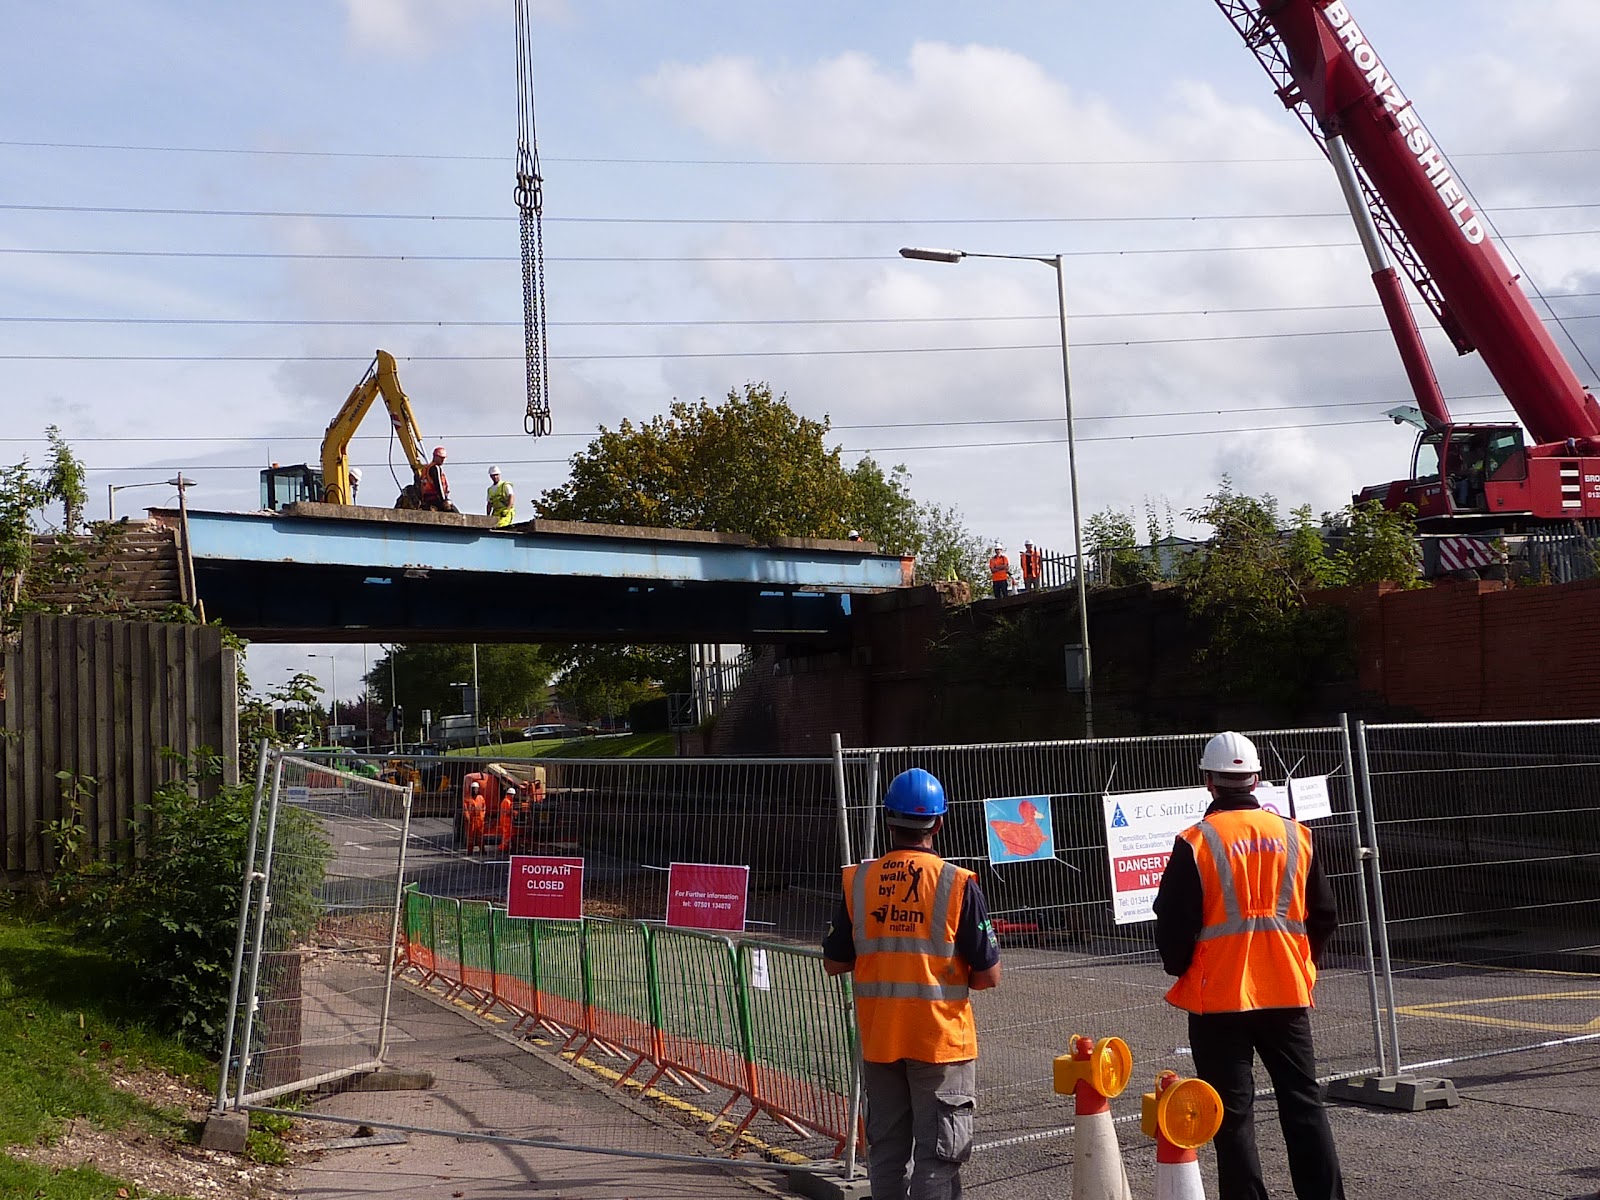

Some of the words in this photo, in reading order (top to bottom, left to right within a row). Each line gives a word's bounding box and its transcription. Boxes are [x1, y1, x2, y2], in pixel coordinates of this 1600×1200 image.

[1324, 0, 1485, 244] BRONZESHIELD
[1160, 802, 1194, 817] Saints
[521, 864, 571, 876] FOOTPATH
[882, 859, 915, 870] don't
[1118, 856, 1162, 873] DANGER
[880, 871, 908, 882] walk
[1139, 873, 1151, 887] IN
[527, 880, 565, 890] CLOSED
[878, 884, 896, 897] by!
[675, 889, 685, 897] For
[685, 890, 706, 898] Further
[706, 892, 739, 900] Information
[890, 904, 924, 924] bam
